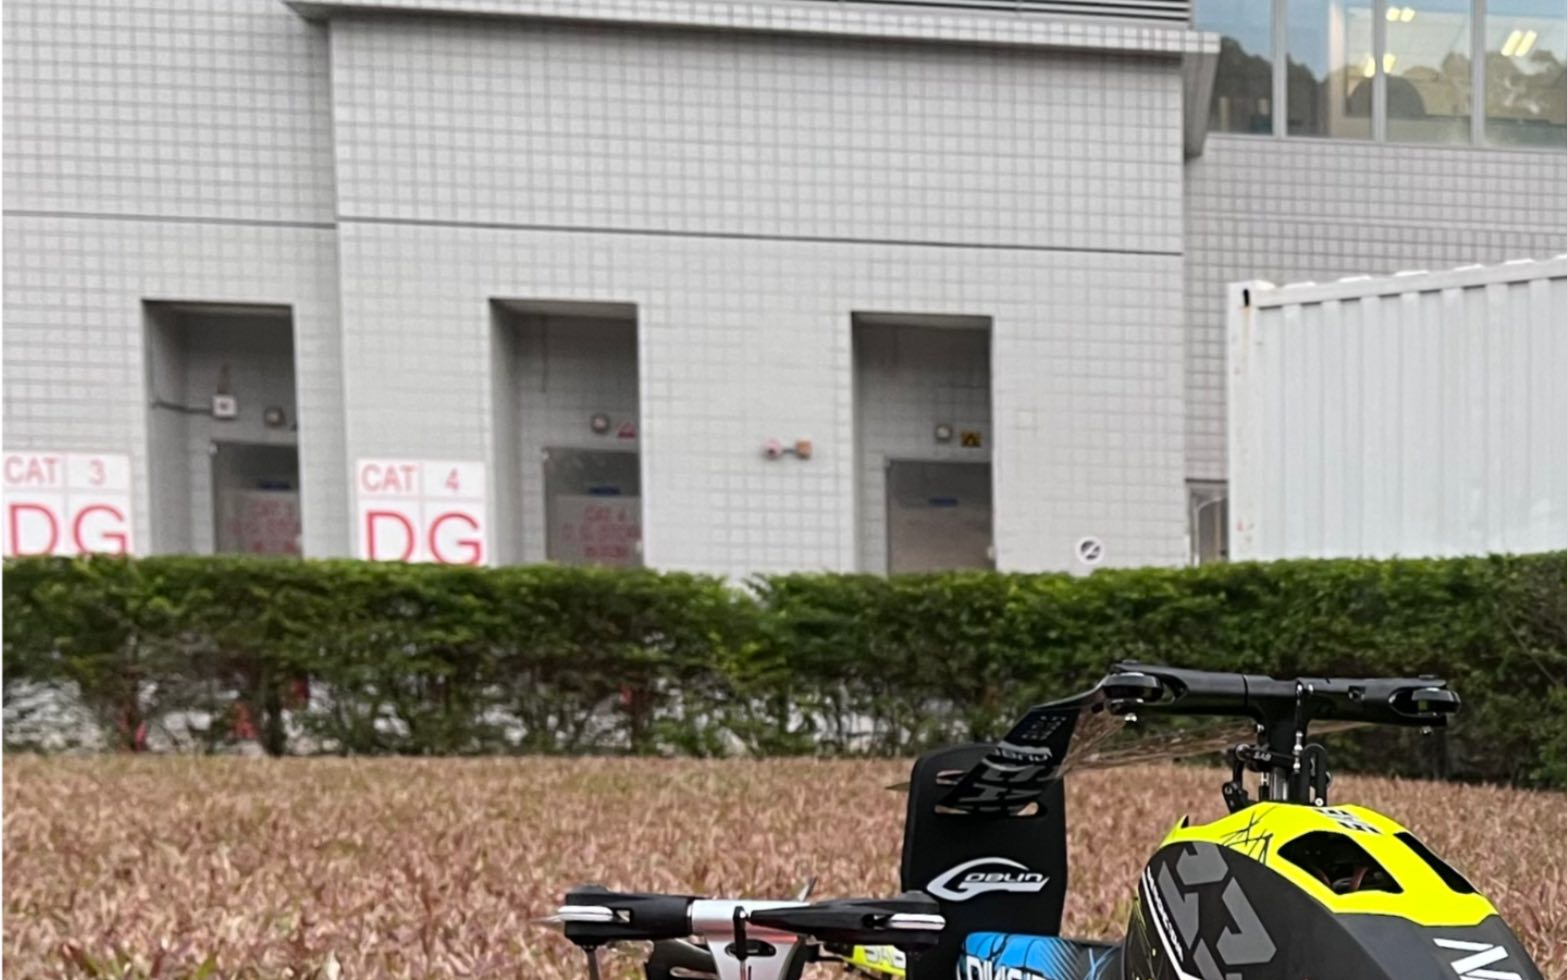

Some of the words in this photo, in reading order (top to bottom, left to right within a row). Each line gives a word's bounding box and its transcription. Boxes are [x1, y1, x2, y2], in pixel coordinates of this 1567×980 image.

[4, 456, 59, 484] CAT
[89, 459, 106, 486] 3
[361, 463, 416, 492] CAT
[445, 467, 460, 491] 4
[10, 503, 127, 558] DG
[366, 510, 482, 566] DG
